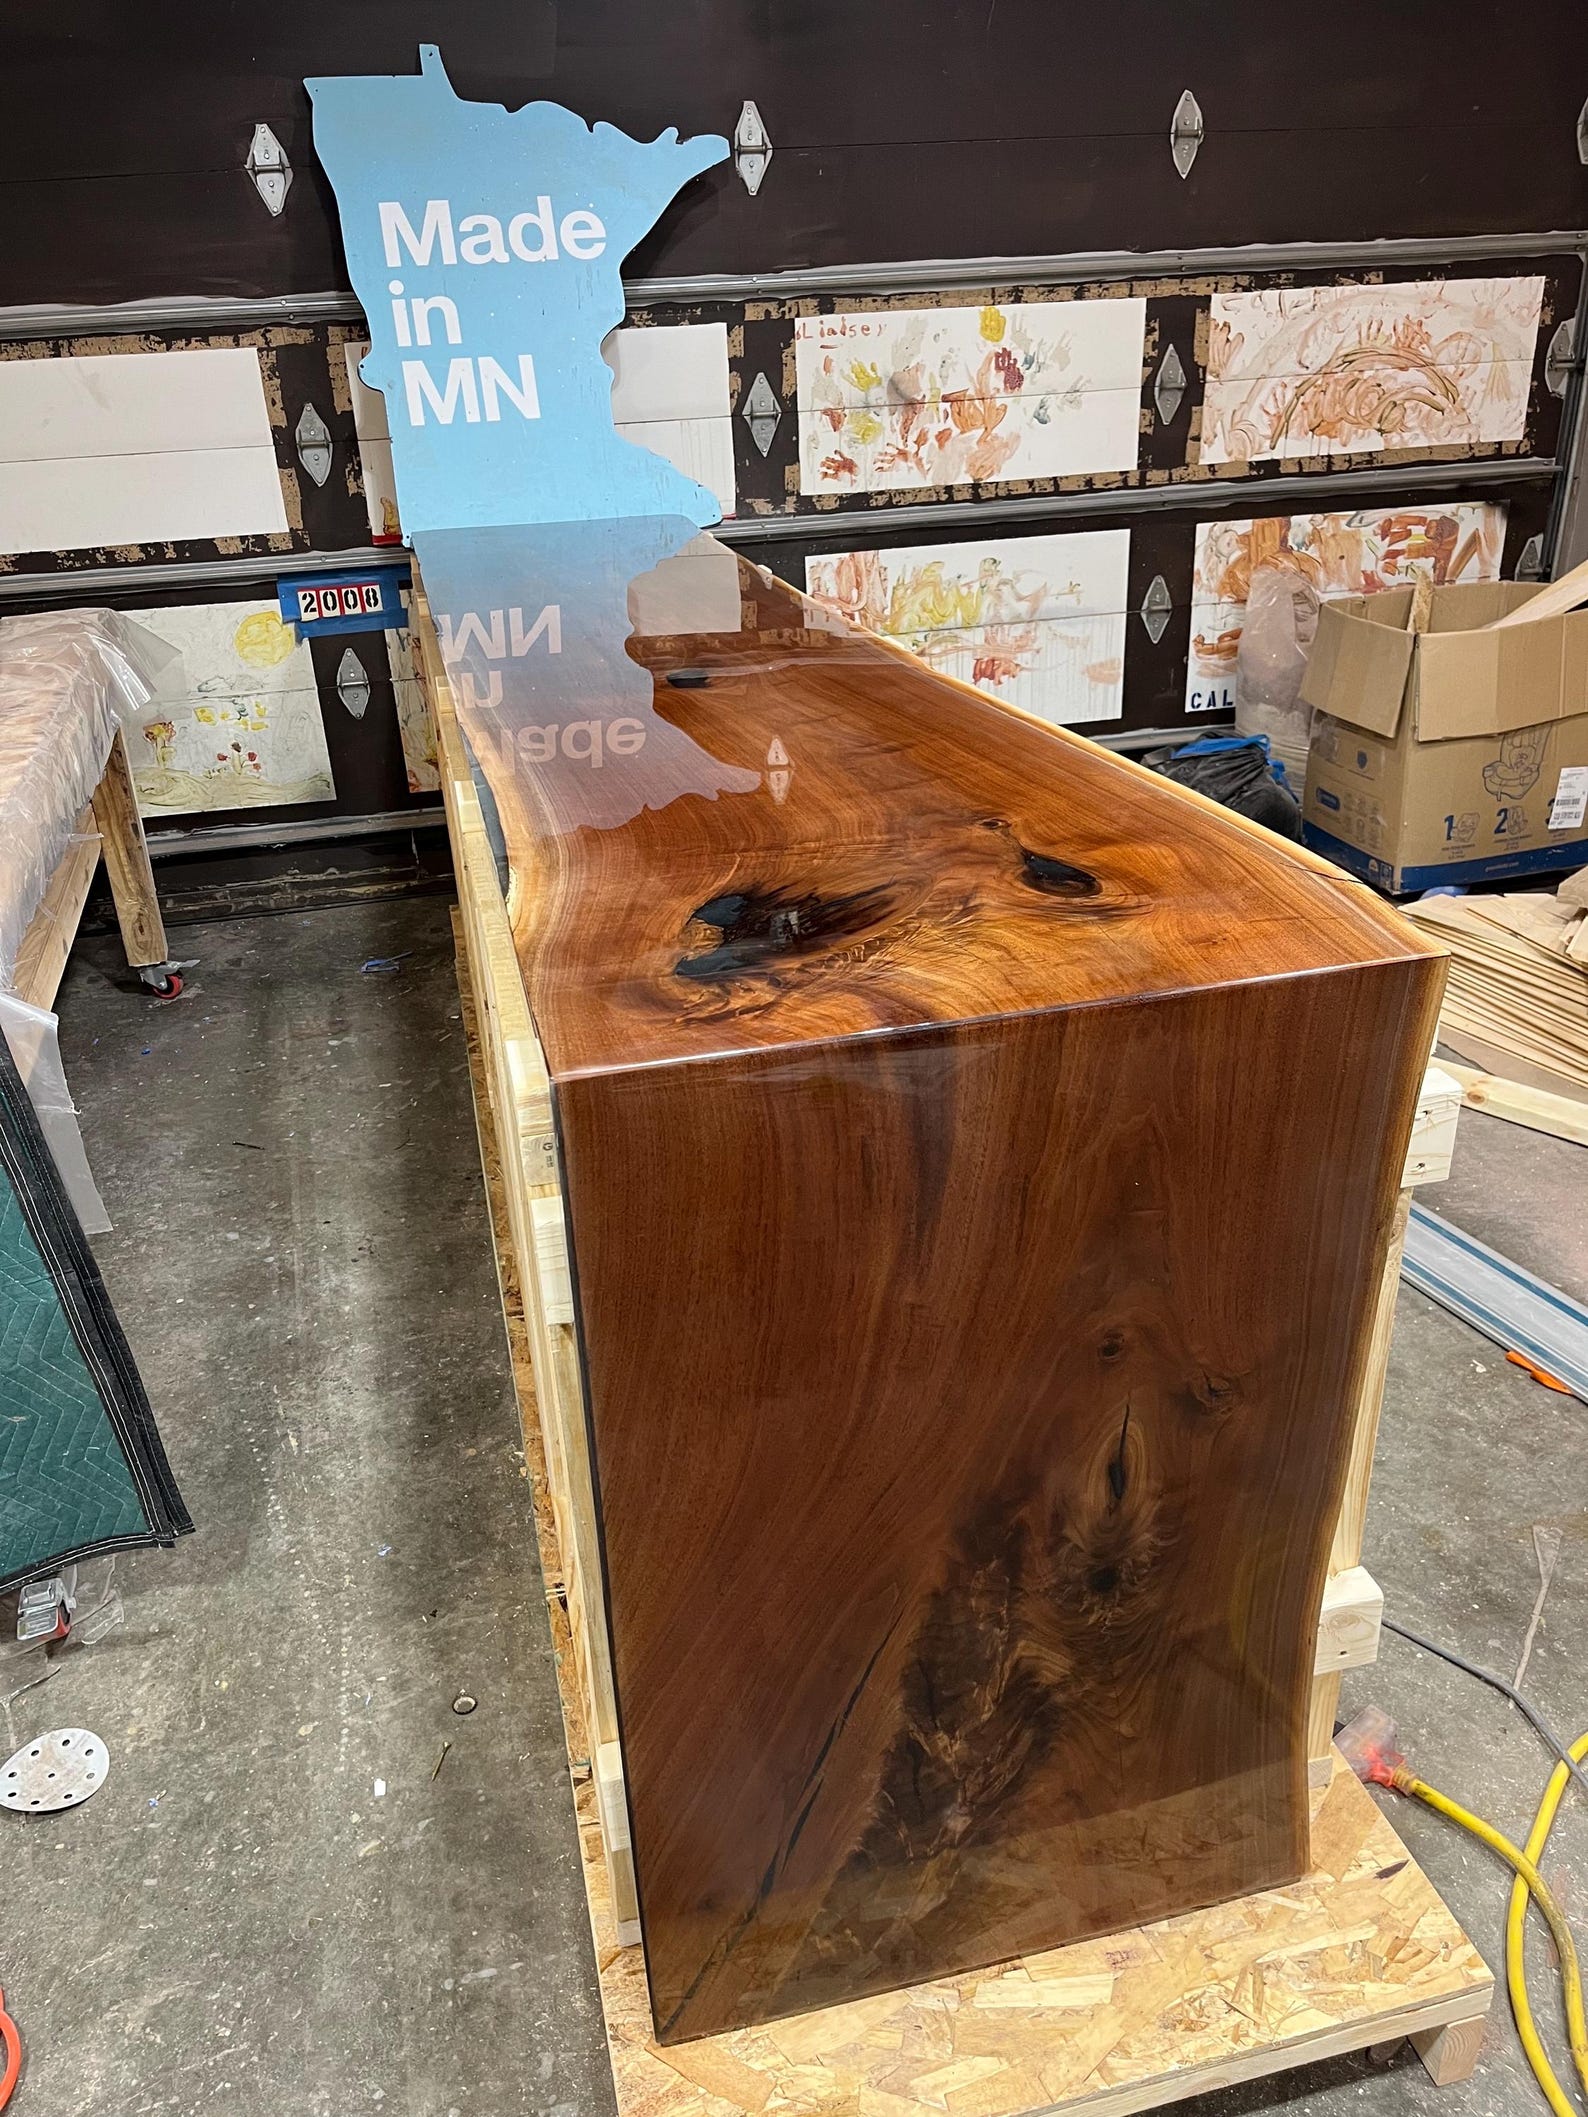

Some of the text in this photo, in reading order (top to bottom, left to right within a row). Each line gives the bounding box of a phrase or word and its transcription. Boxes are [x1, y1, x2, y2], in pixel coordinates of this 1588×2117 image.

[378, 195, 607, 268] Made
[388, 279, 463, 347] in
[402, 354, 542, 426] MN
[301, 587, 379, 613] 2008
[1191, 689, 1234, 709] CAL
[1444, 815, 1455, 841] 1
[1494, 807, 1509, 835] 2
